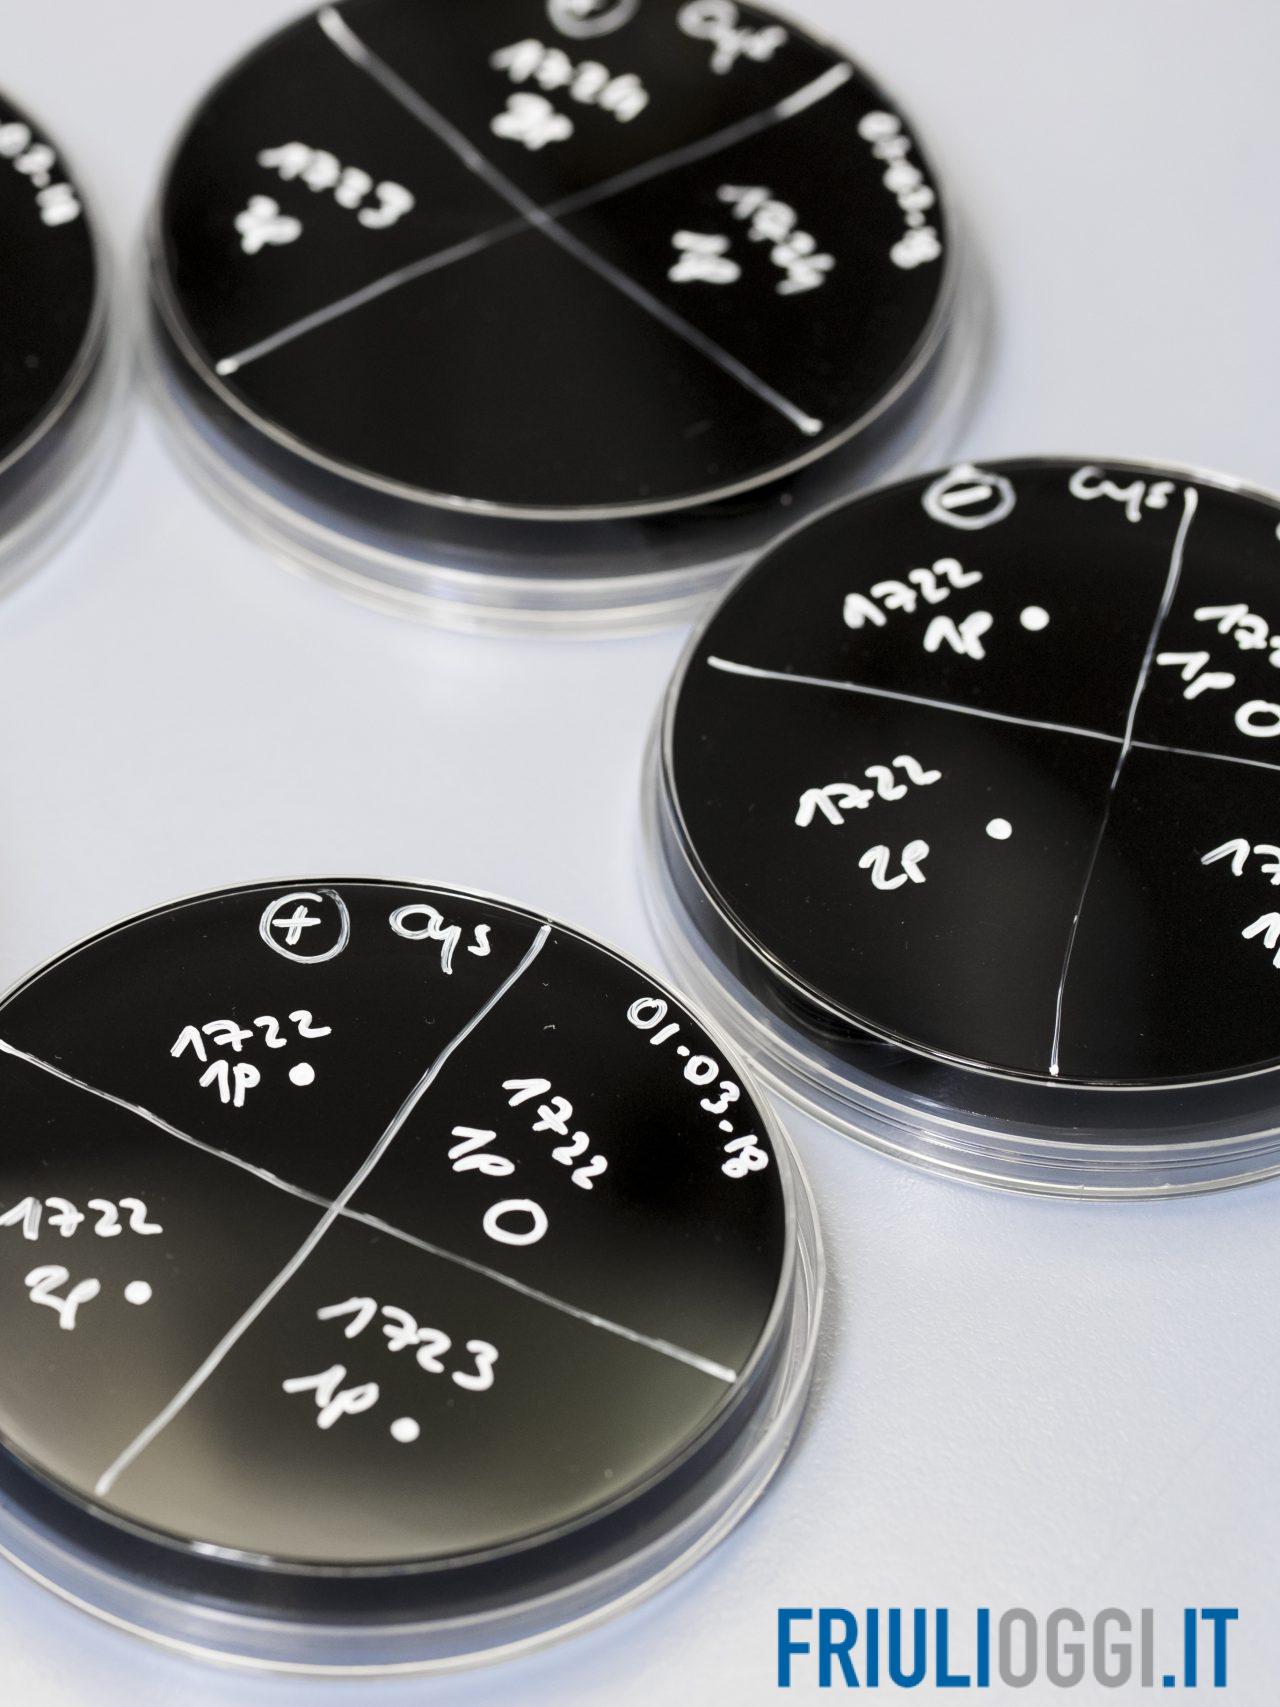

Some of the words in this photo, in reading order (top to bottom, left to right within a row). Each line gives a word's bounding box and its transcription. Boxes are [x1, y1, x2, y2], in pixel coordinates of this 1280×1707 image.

[1069, 466, 1175, 523] Cys
[844, 558, 982, 628] 1722
[795, 755, 941, 827] 1722
[170, 1010, 332, 1059] 1722
[502, 1078, 607, 1189] 1722
[318, 1296, 498, 1391] 1723
